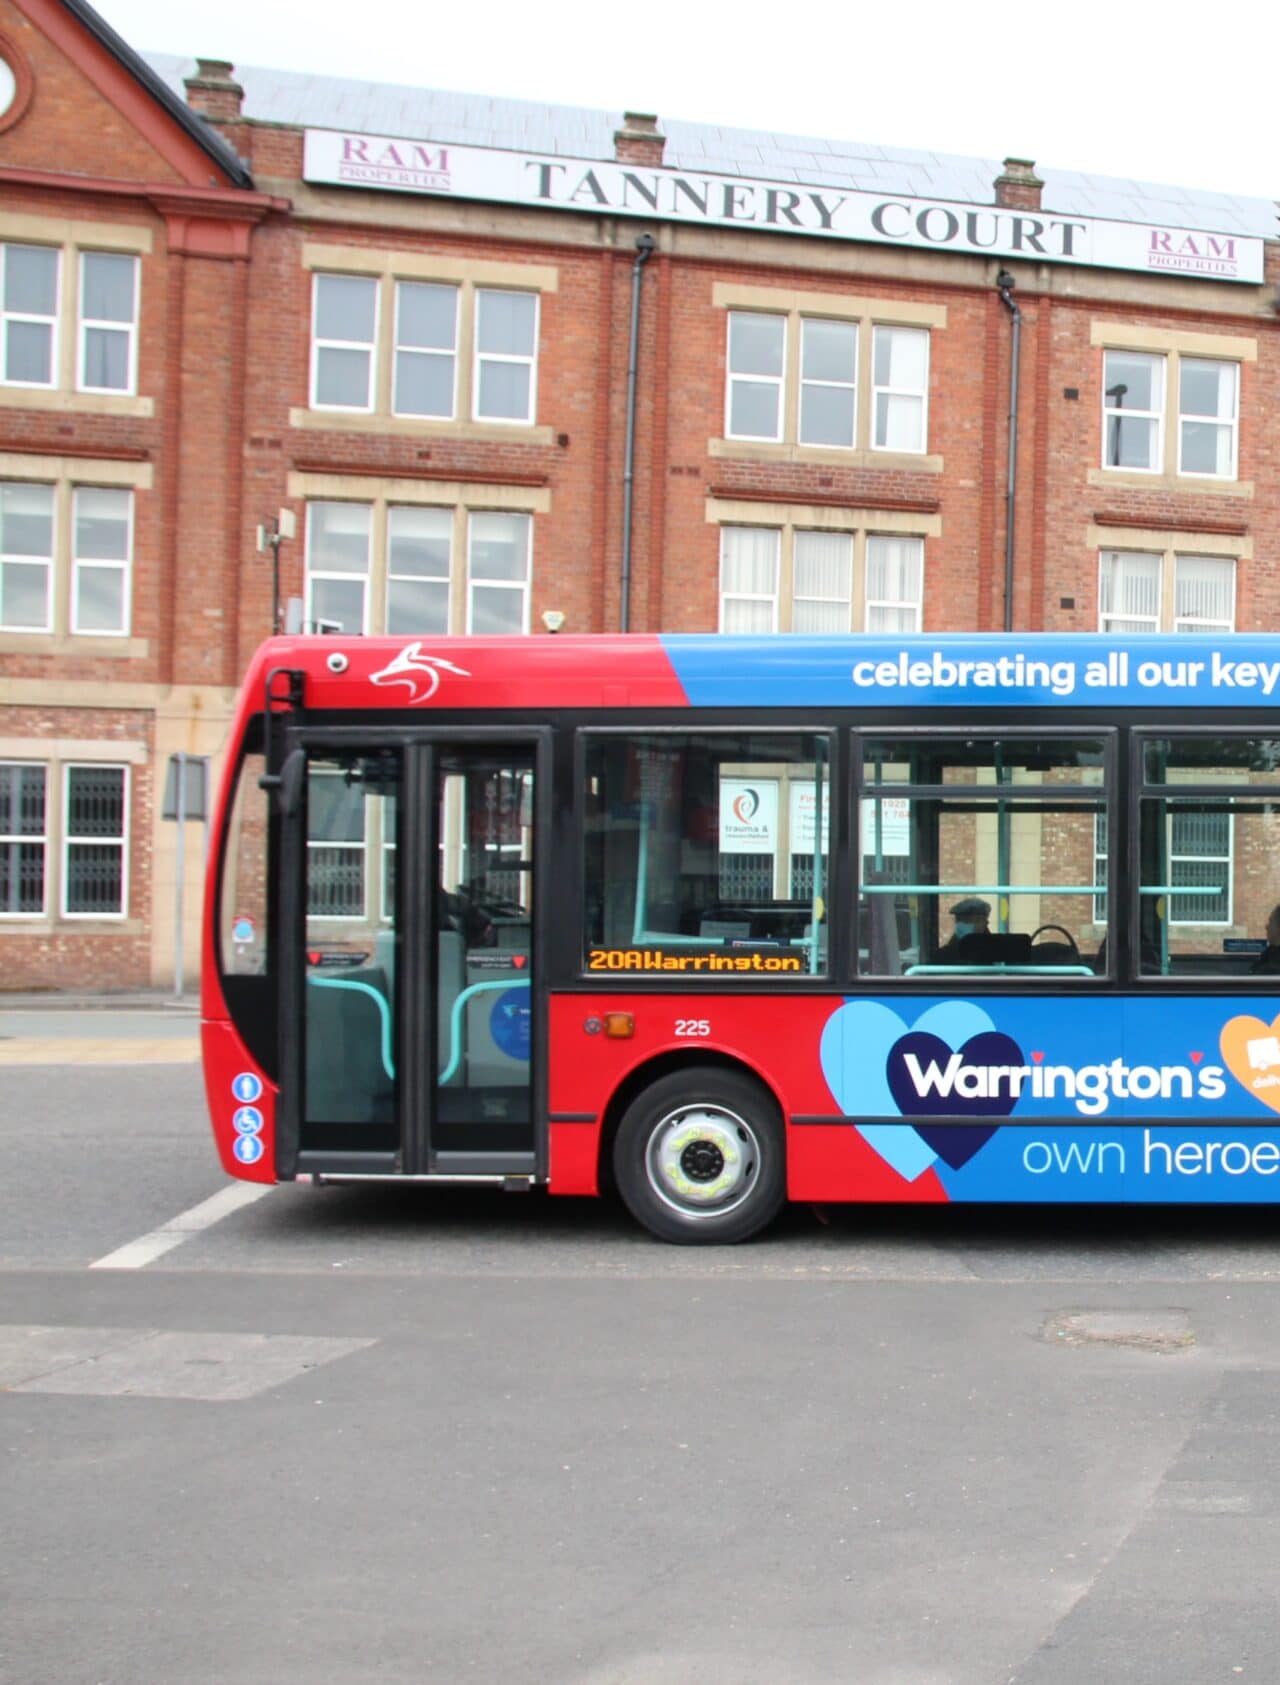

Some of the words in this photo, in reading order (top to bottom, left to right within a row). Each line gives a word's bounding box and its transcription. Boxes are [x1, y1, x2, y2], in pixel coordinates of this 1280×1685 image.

[342, 138, 449, 171] RAM
[339, 166, 451, 186] PROPERTIES
[525, 161, 847, 229] TANNERY
[870, 202, 1087, 256] COURT
[1150, 230, 1236, 259] RAM
[1148, 255, 1238, 273] PROPERTIES
[852, 652, 1076, 695] celebrating
[1084, 652, 1129, 687] all
[1137, 661, 1204, 687] our
[674, 1019, 711, 1037] 225
[1023, 1141, 1126, 1174] own
